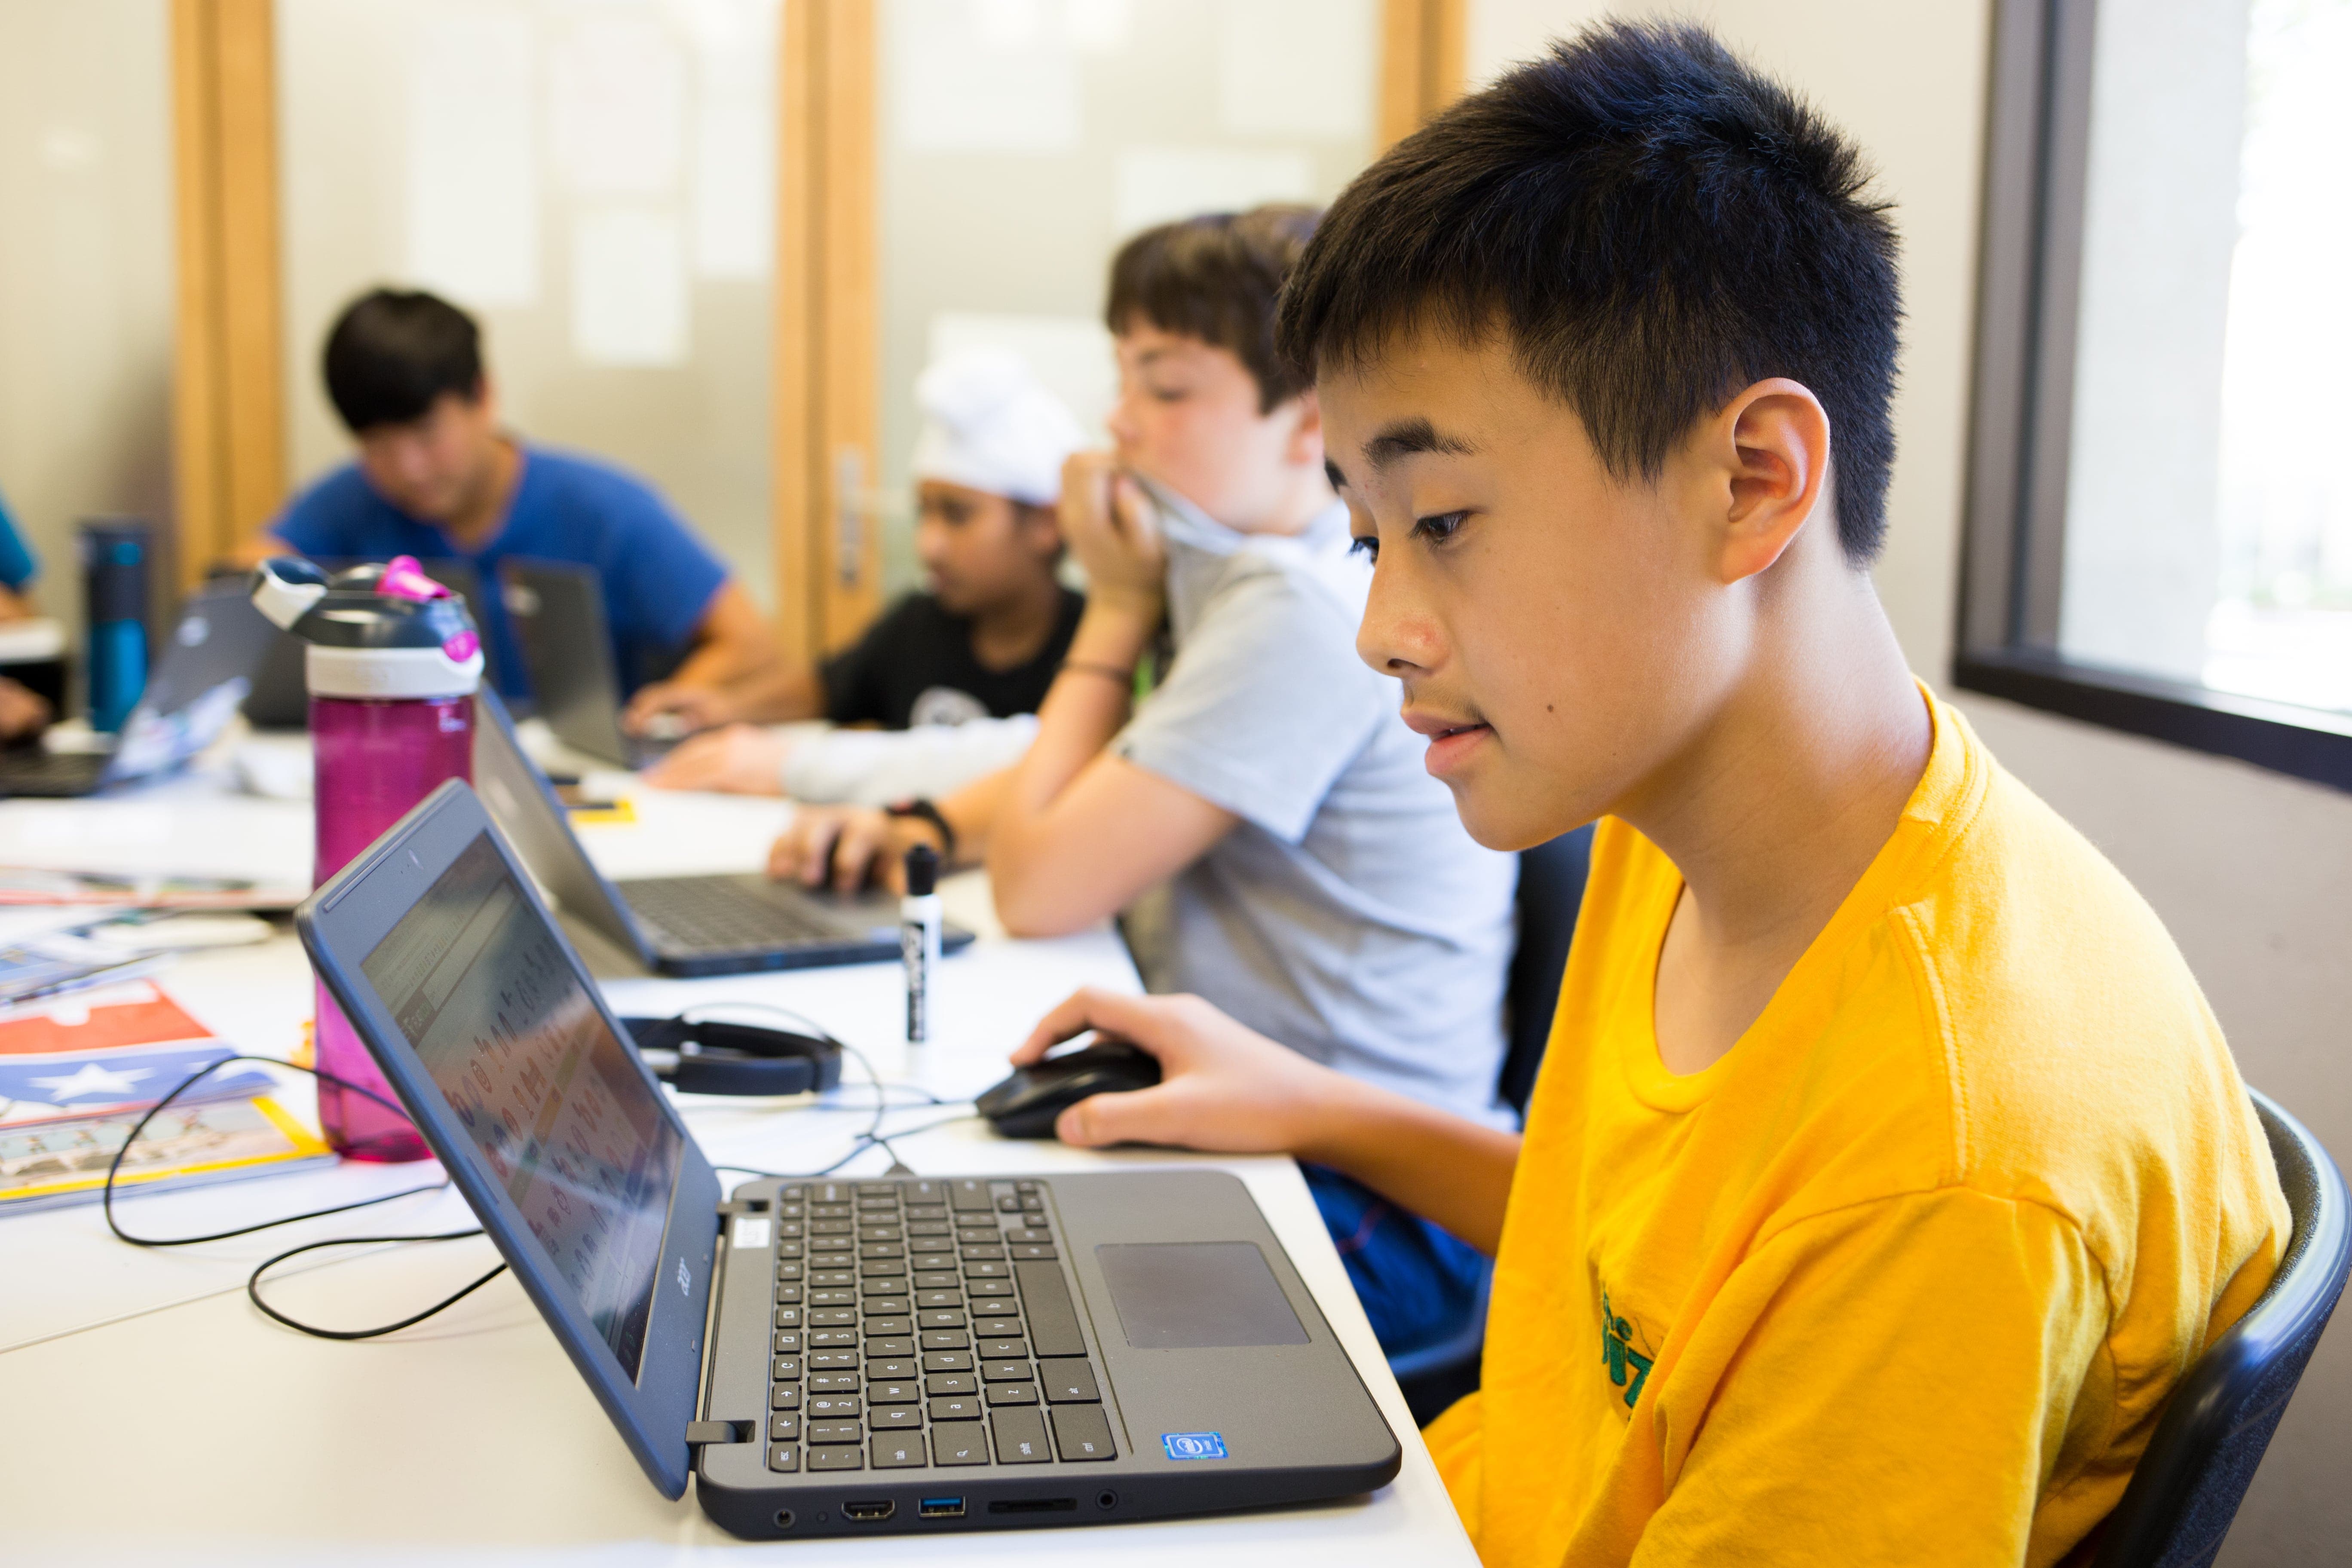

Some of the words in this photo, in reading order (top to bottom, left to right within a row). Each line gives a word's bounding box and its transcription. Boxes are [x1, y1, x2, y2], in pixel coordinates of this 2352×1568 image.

[1068, 1387, 1079, 1395] alt
[1019, 1442, 1032, 1455] shift
[1082, 1442, 1093, 1452] ctrl
[1182, 1439, 1197, 1452] intel
[780, 1451, 789, 1461] esc
[894, 1450, 905, 1460] tab
